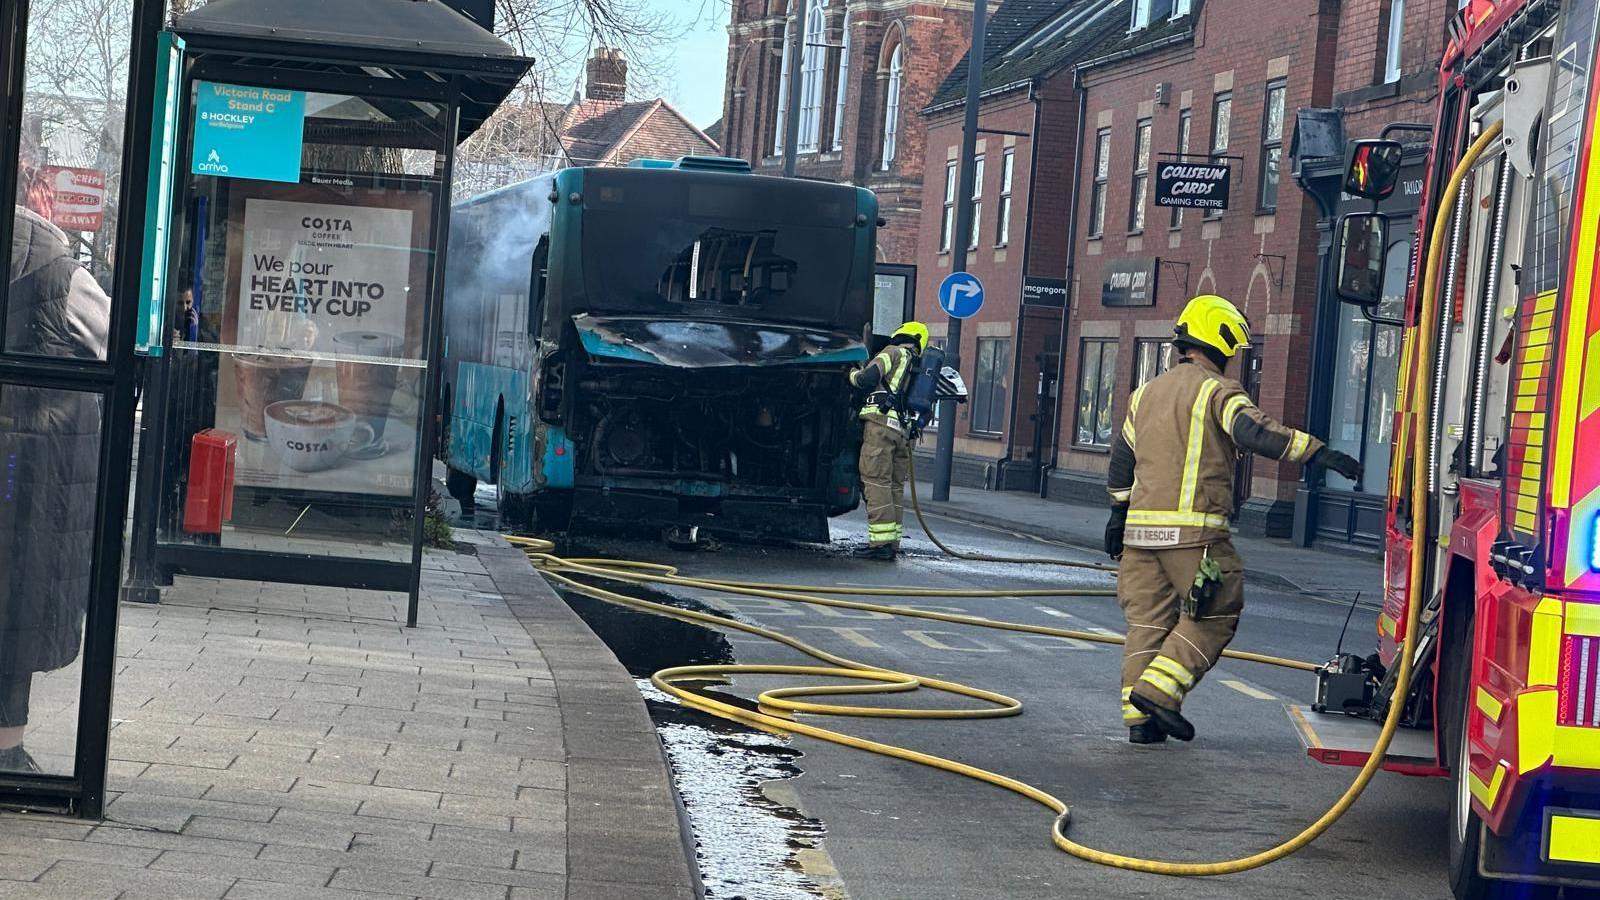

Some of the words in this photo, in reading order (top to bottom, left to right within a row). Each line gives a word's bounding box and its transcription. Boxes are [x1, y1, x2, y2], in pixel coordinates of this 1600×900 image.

[214, 86, 259, 99] Victoria
[262, 90, 292, 102] Road
[228, 100, 262, 112] Stand
[265, 103, 275, 113] C
[201, 112, 208, 120] 8
[209, 113, 255, 124] HOCKLEY
[198, 162, 229, 173] arriva
[1161, 165, 1227, 180] COLISEUM
[312, 176, 332, 185] Bauer
[333, 178, 354, 187] Media
[1171, 181, 1215, 195] CARDS
[1160, 197, 1192, 206] GAMING
[1194, 199, 1223, 207] CENTRE
[301, 217, 353, 231] COSTA
[312, 232, 341, 241] COFFEE
[253, 253, 284, 273] We
[289, 259, 334, 277] pour
[251, 274, 328, 297] HEART
[331, 279, 385, 300] INTO
[1024, 284, 1067, 295] mcgregors
[250, 293, 323, 315] EVERY
[325, 298, 372, 317] CUP
[286, 440, 329, 452] COSTA
[1143, 530, 1176, 542] RESCUE
